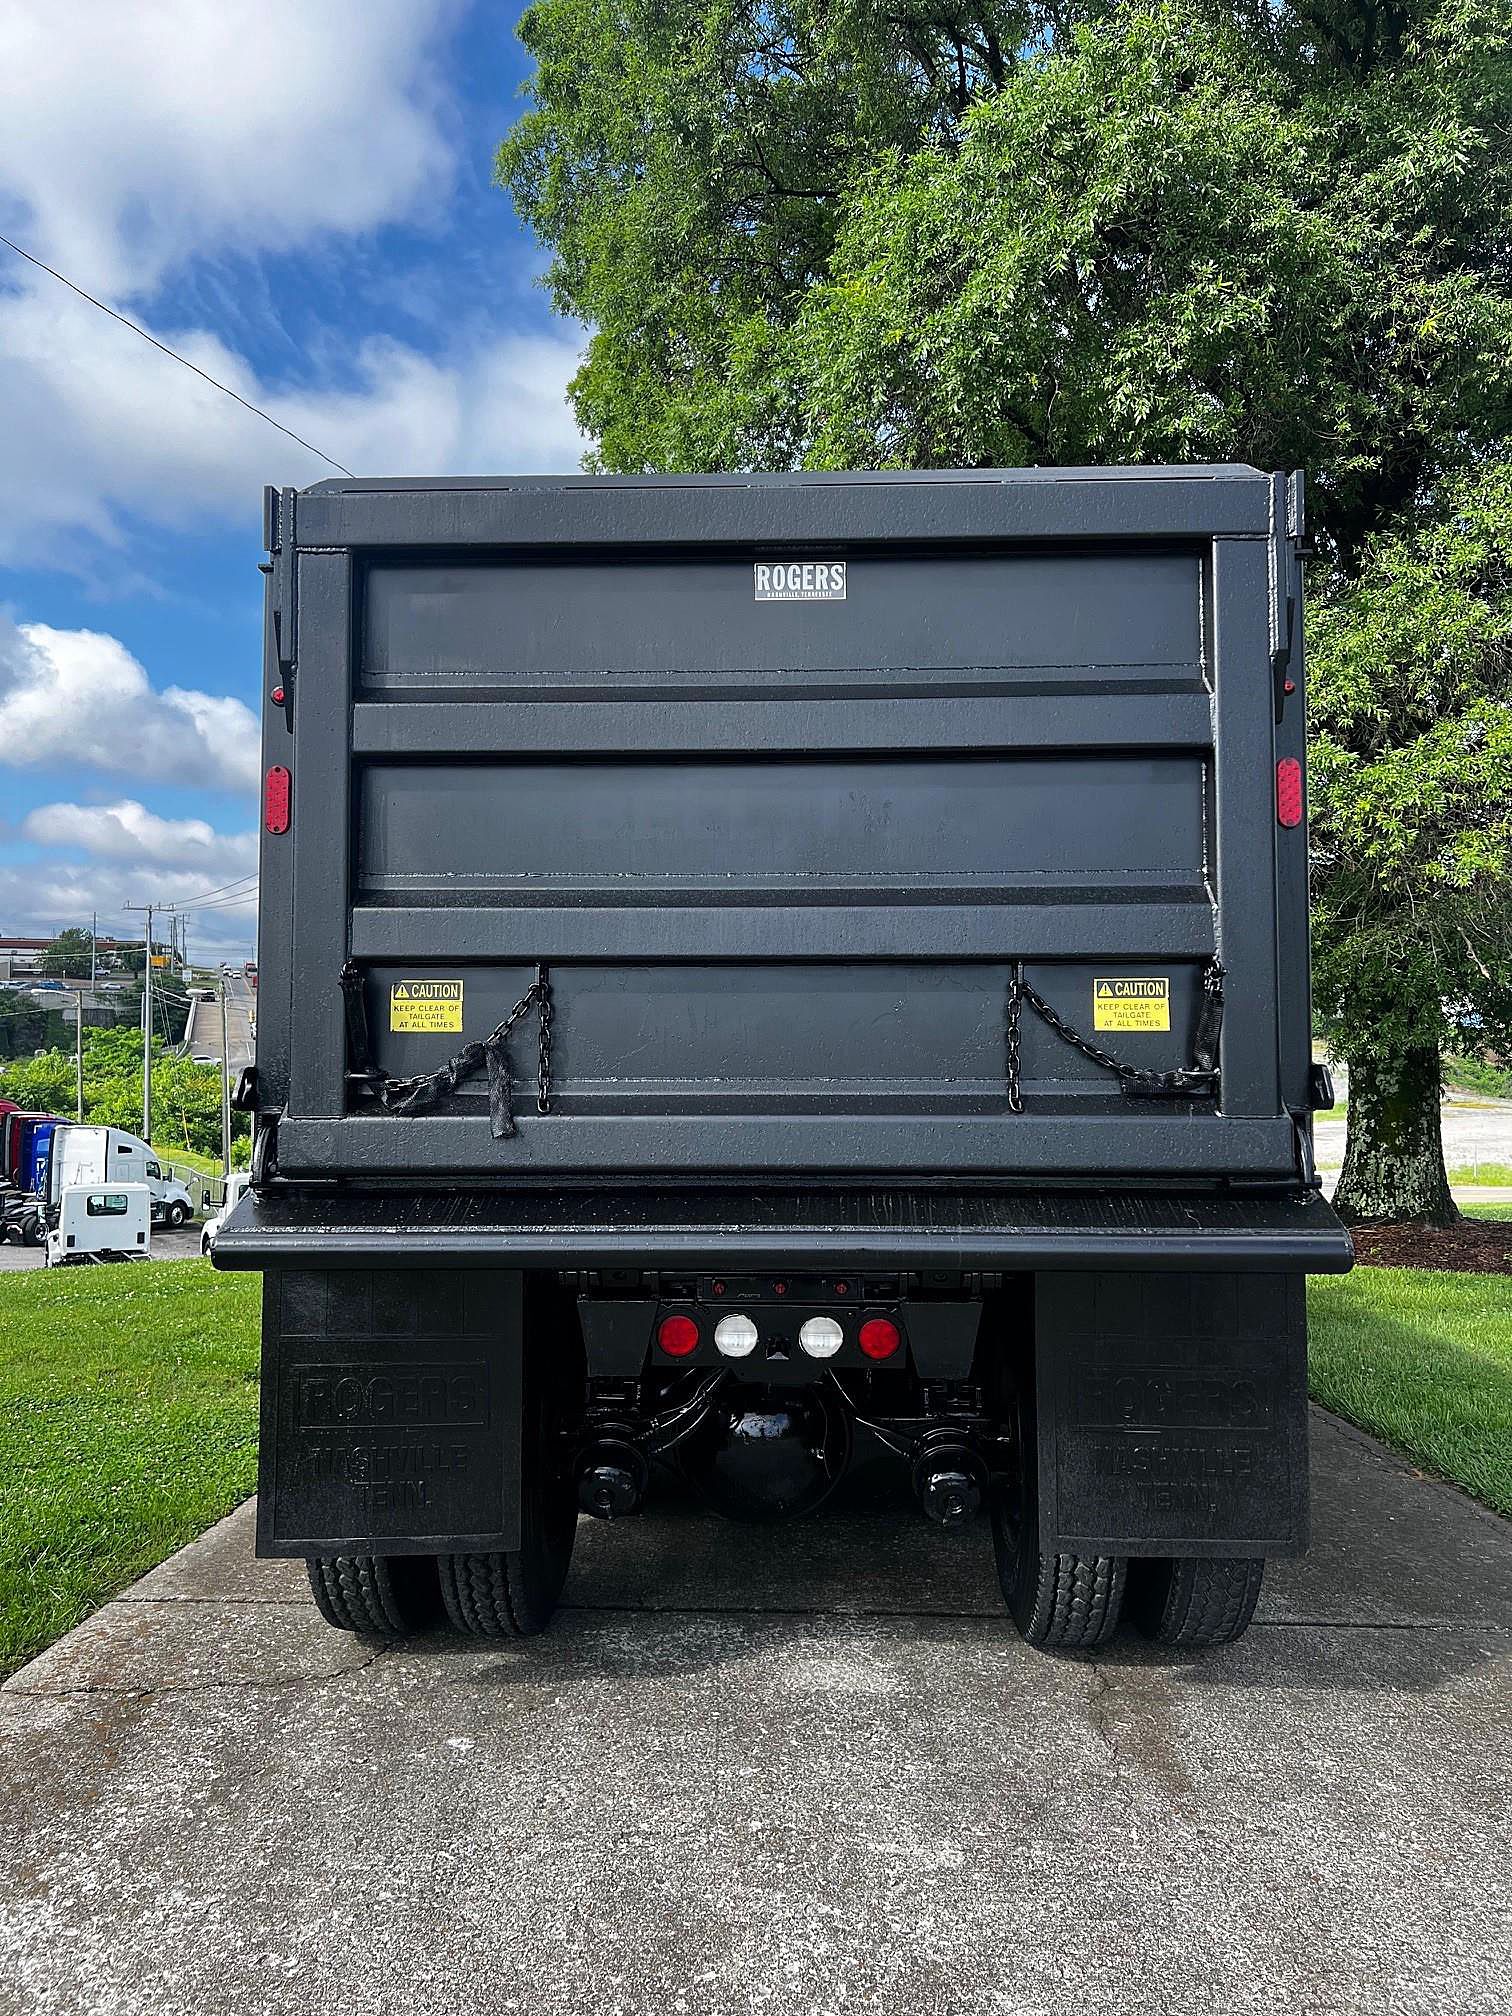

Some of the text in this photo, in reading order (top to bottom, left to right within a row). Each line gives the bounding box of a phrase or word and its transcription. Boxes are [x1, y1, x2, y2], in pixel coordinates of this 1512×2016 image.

[757, 565, 843, 590] ROGERS
[411, 984, 458, 998] CAUTION
[1115, 982, 1164, 996] CAUTION
[300, 1376, 476, 1418] ROGERS
